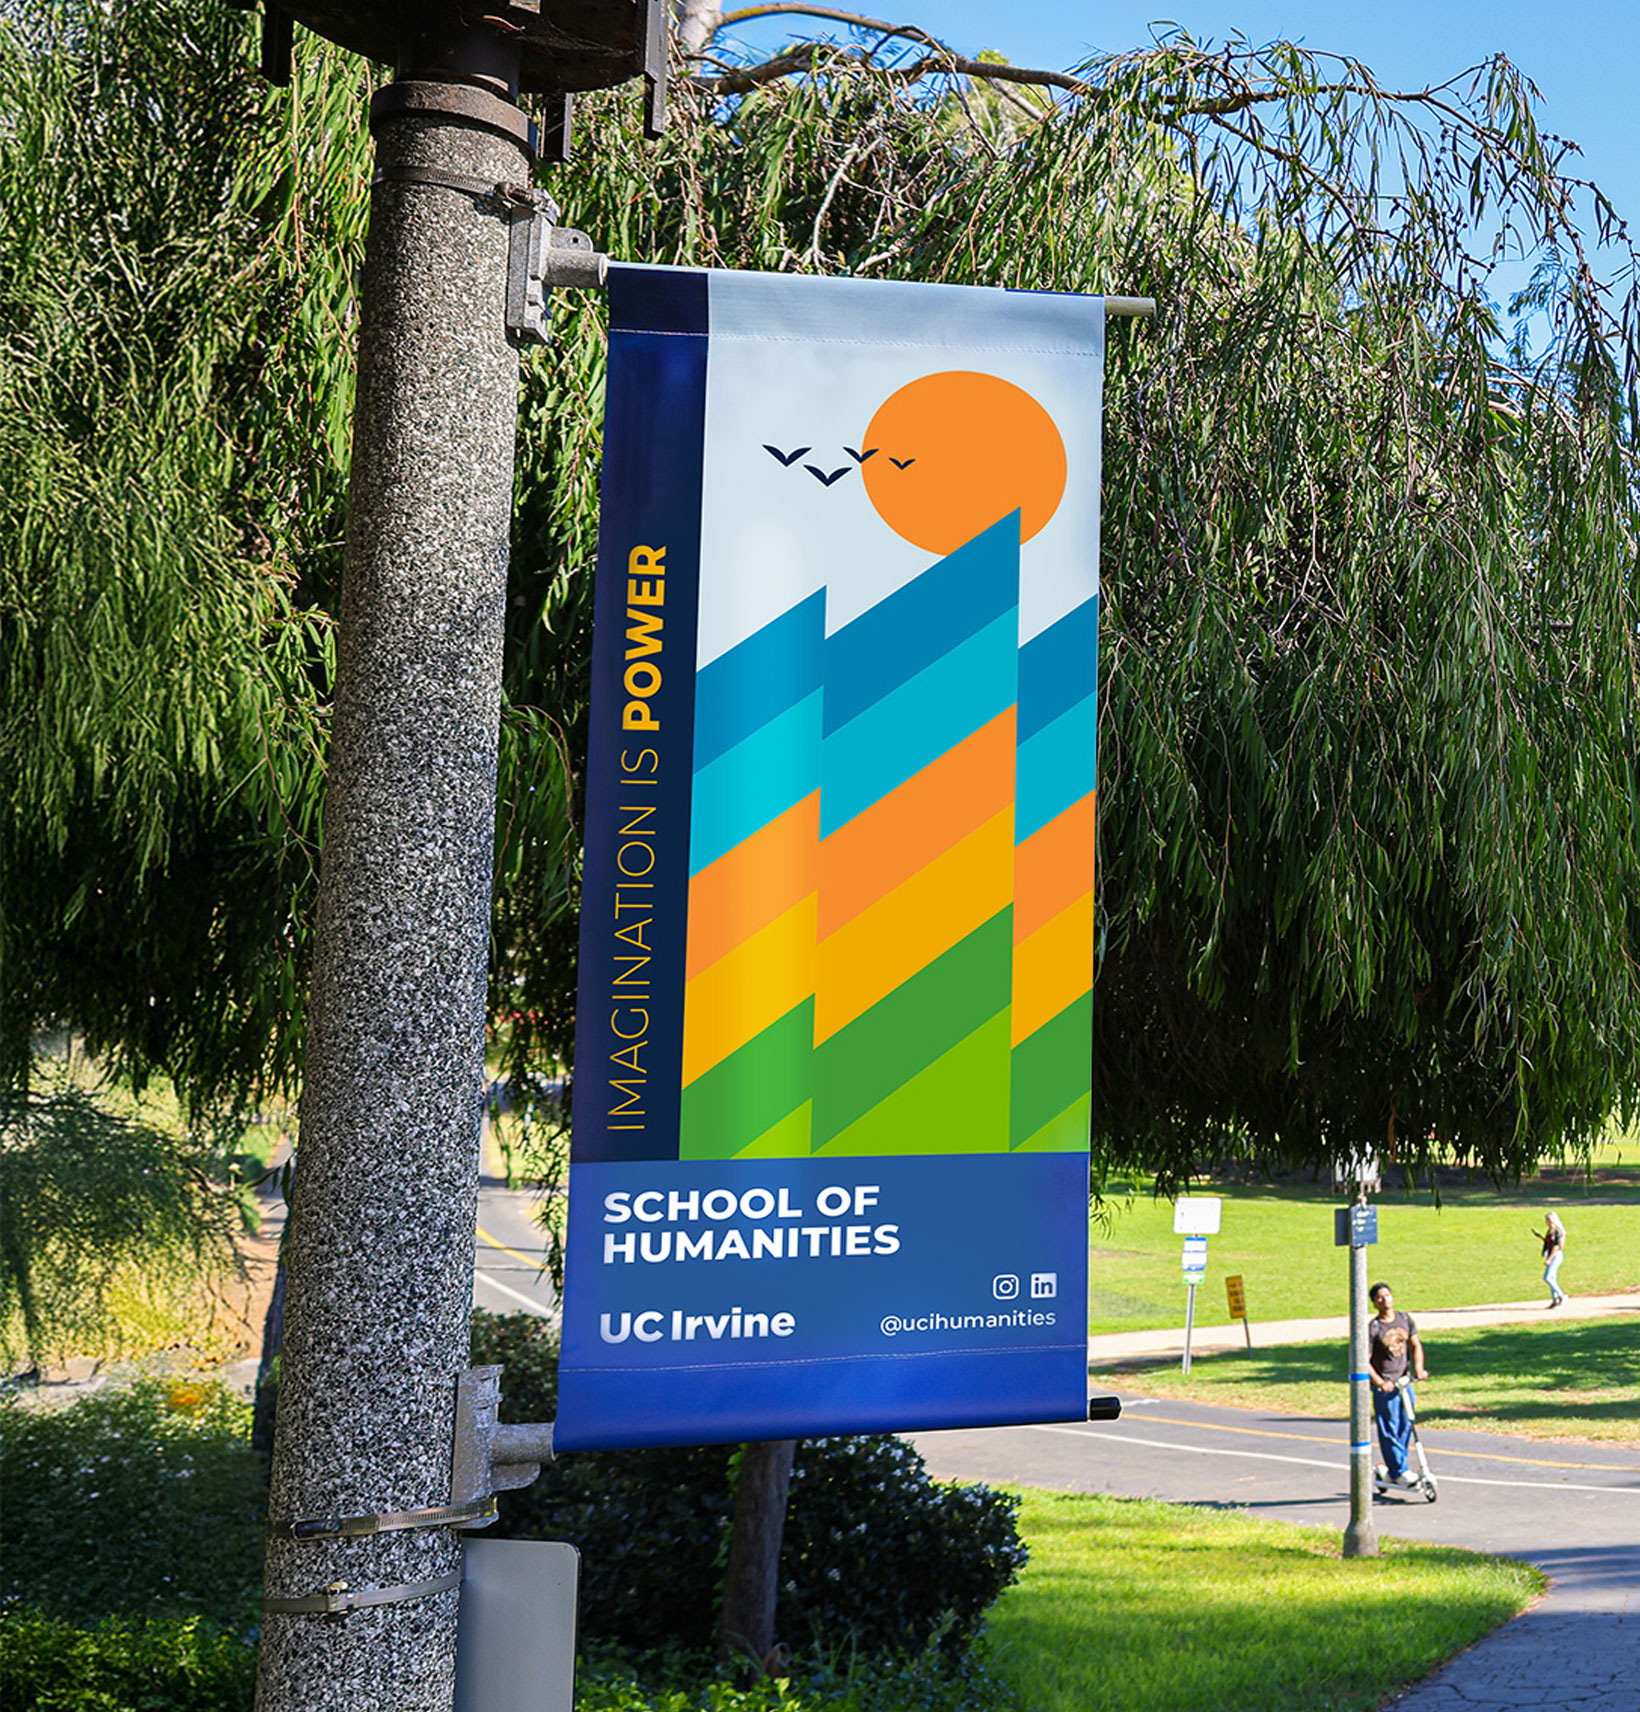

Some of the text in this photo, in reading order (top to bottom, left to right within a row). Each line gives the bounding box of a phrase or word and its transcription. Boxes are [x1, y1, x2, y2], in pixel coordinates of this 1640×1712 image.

[607, 544, 667, 1130] IMAGINATION IS POWER
[603, 1185, 880, 1223] SCHOOL OF
[603, 1224, 900, 1264] HUMANITIES
[1033, 1276, 1054, 1296] in
[601, 1306, 796, 1344] UC Irvine
[880, 1309, 1056, 1336] @ucihumanities
